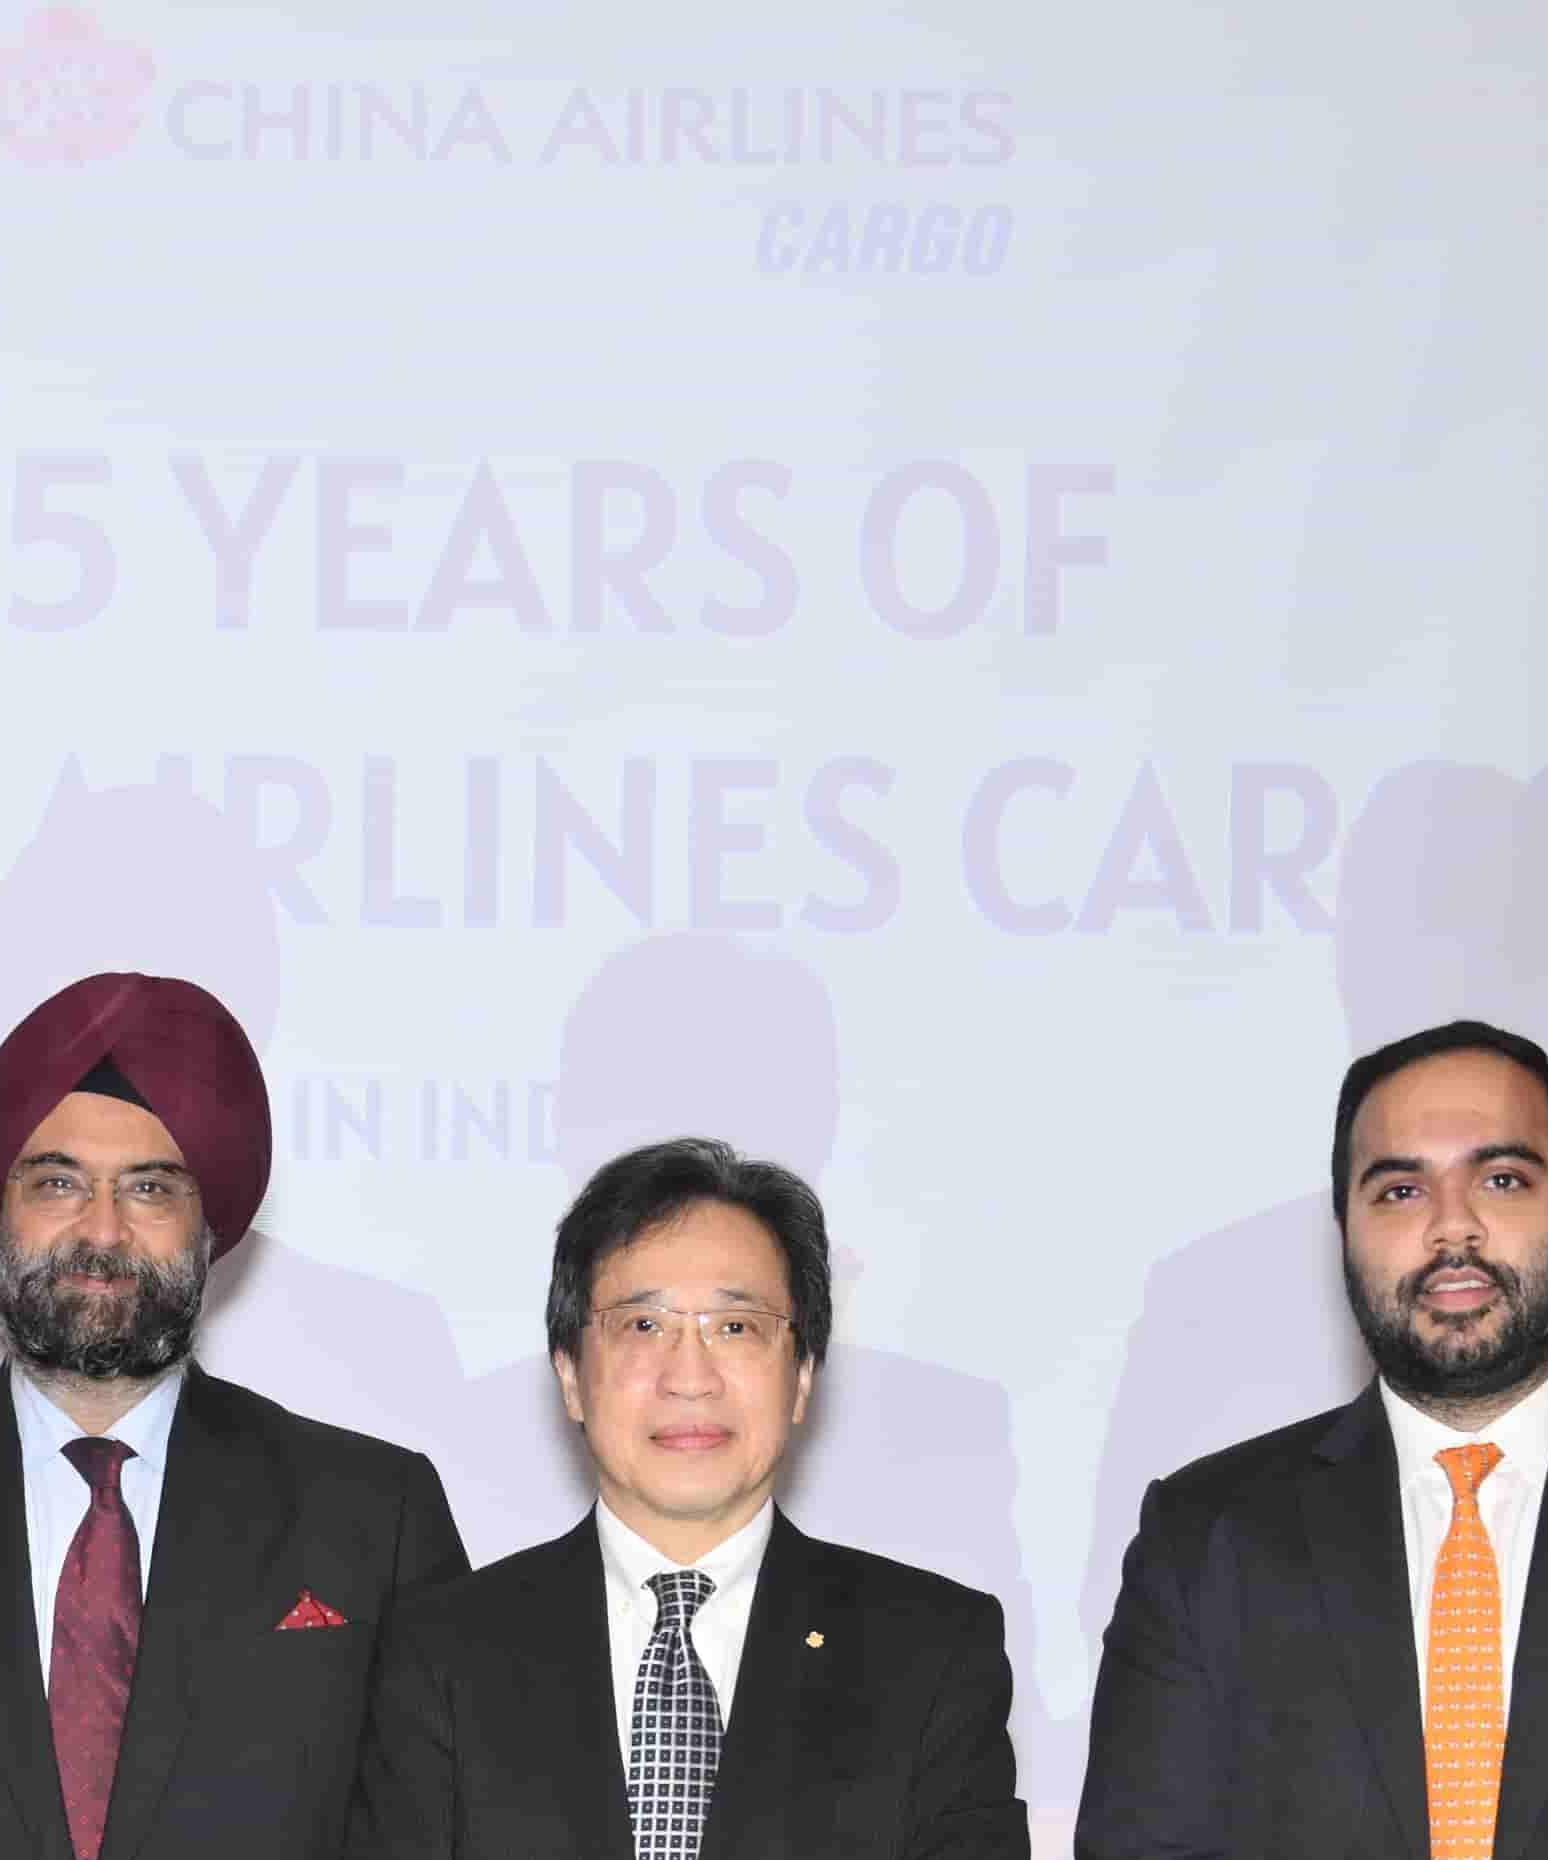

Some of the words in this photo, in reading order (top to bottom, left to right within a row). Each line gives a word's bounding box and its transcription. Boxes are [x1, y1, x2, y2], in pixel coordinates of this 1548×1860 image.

[166, 80, 511, 164] CHINA
[537, 86, 1017, 168] AIRLINES
[755, 203, 1016, 274] CARGO
[168, 455, 801, 637] YEARS
[859, 453, 1116, 639] OF
[24, 751, 903, 933] RLINES
[291, 1078, 383, 1161] IN
